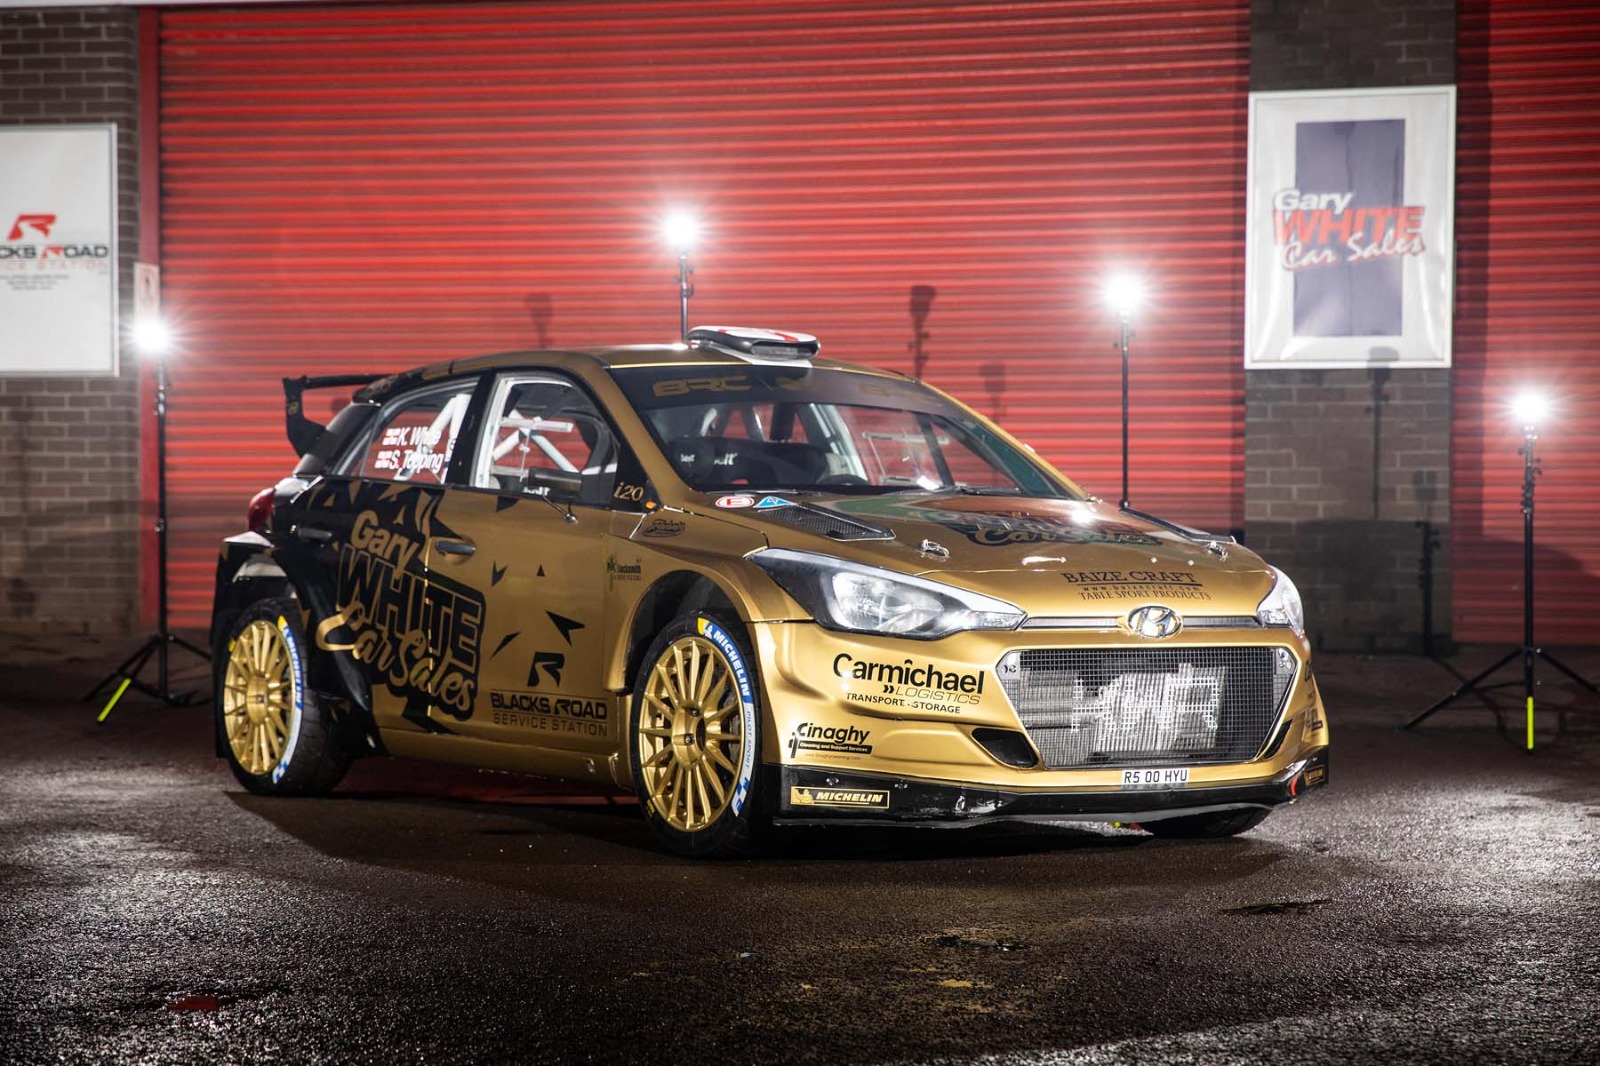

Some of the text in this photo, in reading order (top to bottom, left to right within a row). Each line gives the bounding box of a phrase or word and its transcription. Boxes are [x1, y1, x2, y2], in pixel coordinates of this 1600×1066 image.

[1273, 188, 1354, 214] Gary
[1273, 206, 1425, 247] WHITE
[1282, 226, 1425, 270] Car Sales
[613, 482, 644, 501] i20
[351, 510, 419, 579] Gary
[1061, 571, 1197, 583] BAIZE CRAFT
[338, 543, 482, 673] WHITE
[1078, 589, 1211, 601] TABLE SPORT PRODUCTS
[316, 600, 475, 712] Car Sales
[713, 630, 750, 696] MICHELIN
[833, 653, 985, 694] Carmichael
[490, 692, 607, 720] BLACKS ROAD
[846, 692, 961, 714] TRANSPORT STORAGE
[896, 686, 981, 705] LOGISTICS
[493, 712, 608, 737] SERVICE STATION
[1124, 772, 1140, 783] R5
[1165, 770, 1188, 782] HYU
[816, 792, 883, 803] MICHELIN
